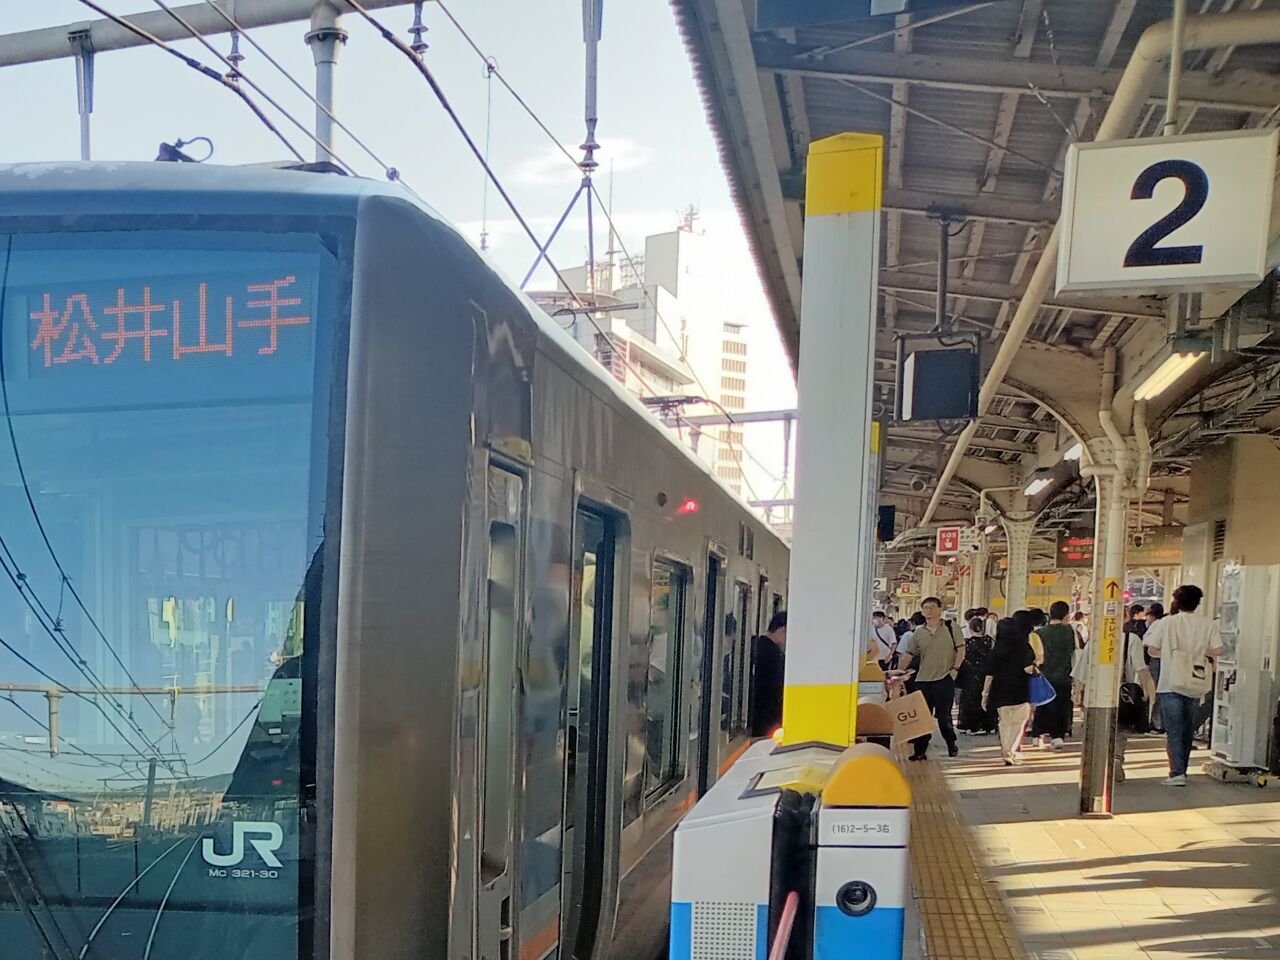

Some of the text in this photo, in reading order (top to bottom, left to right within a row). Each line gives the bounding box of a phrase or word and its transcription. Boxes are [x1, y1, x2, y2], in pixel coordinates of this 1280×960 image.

[1123, 159, 1210, 268] 2
[30, 275, 311, 367] 松井山手
[941, 531, 957, 539] SOS
[1107, 618, 1117, 662] エレベーター
[897, 708, 917, 722] GU
[202, 821, 284, 868] JR
[231, 870, 278, 879] 321-30
